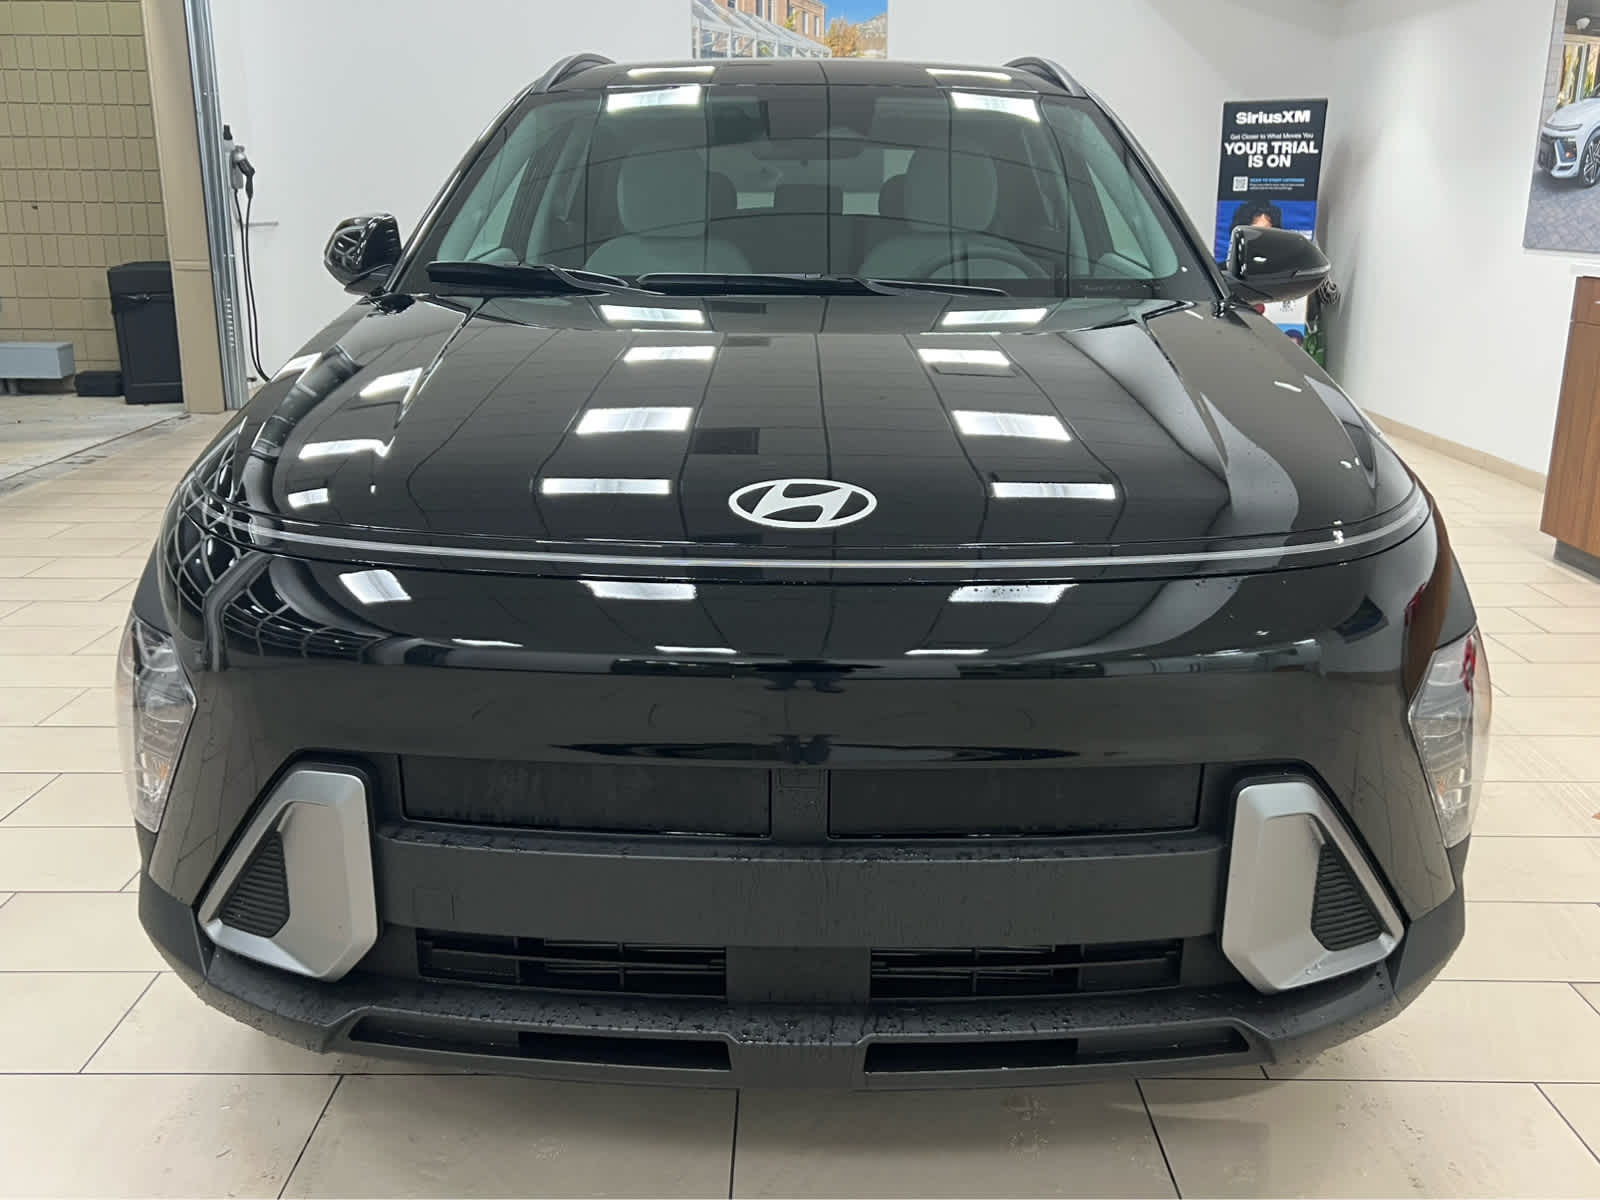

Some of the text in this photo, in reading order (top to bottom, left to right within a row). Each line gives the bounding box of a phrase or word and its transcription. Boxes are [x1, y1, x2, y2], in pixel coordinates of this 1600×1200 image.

[1236, 110, 1311, 124] SiriusXM
[1224, 141, 1319, 155] YOUR TRIAL
[1248, 155, 1291, 168] IS ON
